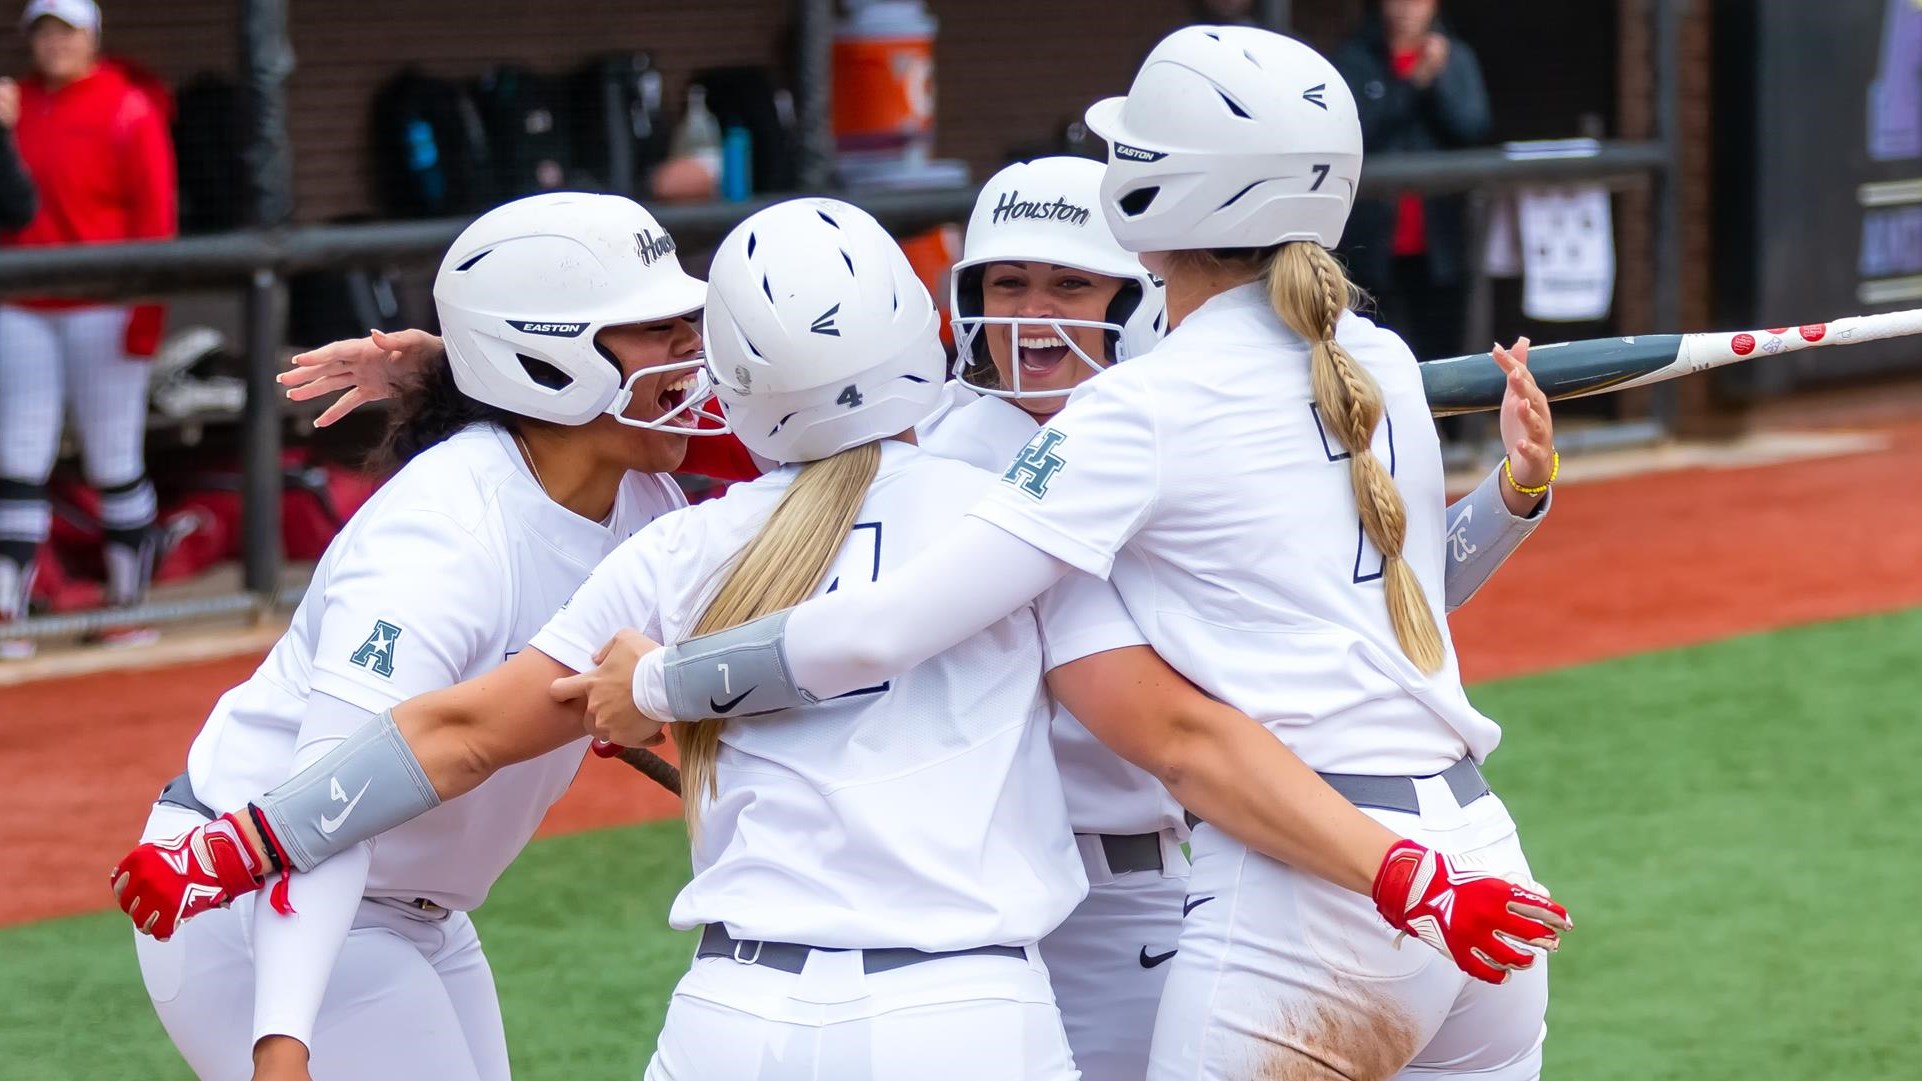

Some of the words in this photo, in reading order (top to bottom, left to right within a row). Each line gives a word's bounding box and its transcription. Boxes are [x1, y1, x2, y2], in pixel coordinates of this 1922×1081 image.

[1117, 145, 1154, 161] EASTON
[1310, 164, 1330, 191] 7
[993, 190, 1090, 225] Houston
[523, 323, 580, 333] EASTON
[837, 384, 863, 408] 4
[350, 619, 402, 678] A
[330, 776, 349, 803] 4
